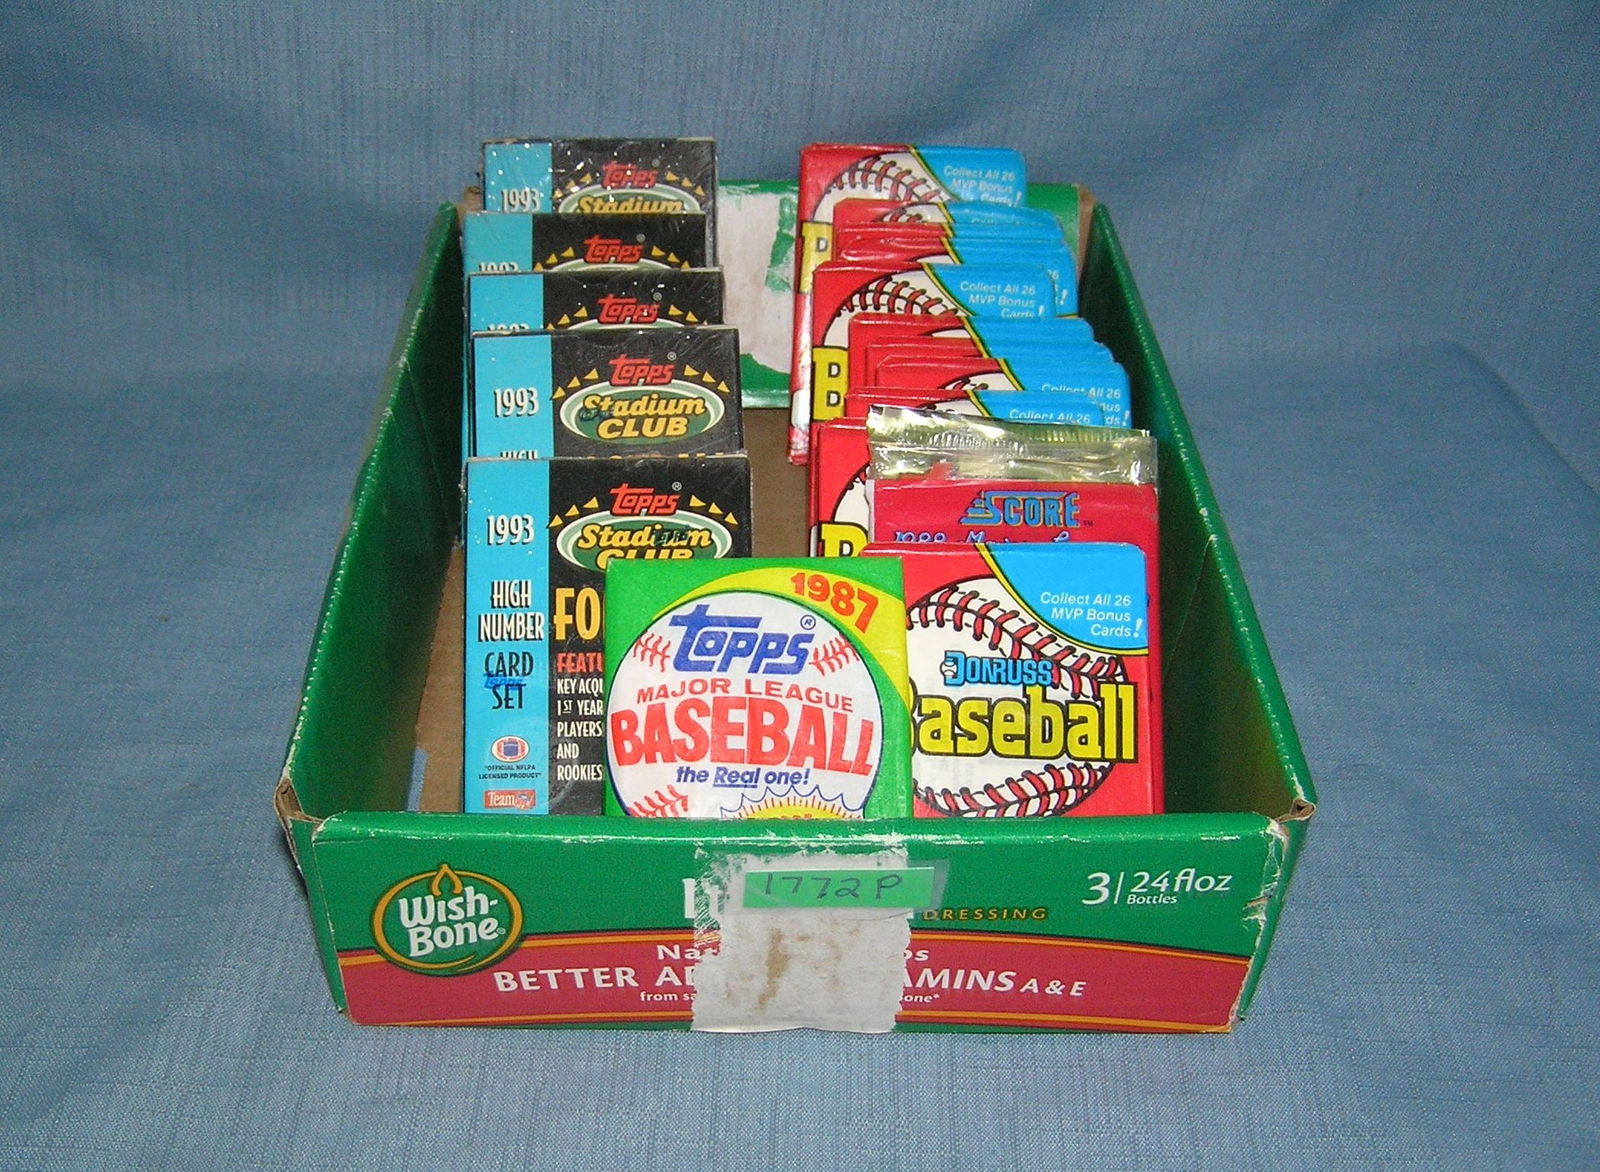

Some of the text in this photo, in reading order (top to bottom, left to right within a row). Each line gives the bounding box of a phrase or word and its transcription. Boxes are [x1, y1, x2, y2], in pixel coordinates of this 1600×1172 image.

[943, 165, 982, 177] Collect
[986, 169, 1000, 179] All
[960, 280, 1036, 295] Collect All 26
[969, 294, 1035, 307] MVP Bonus
[494, 387, 539, 417] 1993
[1106, 388, 1121, 399] 26
[597, 416, 689, 440] CLUB
[1077, 414, 1091, 424] 26
[959, 490, 1080, 528] SCORE
[487, 515, 535, 546] 1993
[491, 580, 532, 609] HIGH
[791, 572, 879, 634] 1987
[1040, 592, 1132, 607] Collect All 26
[1051, 608, 1131, 622] MVP Bonus
[479, 612, 544, 642] NUMBER
[484, 651, 534, 677] CARD
[492, 683, 527, 709] SET
[557, 679, 576, 695] KEY
[636, 678, 854, 713] MAJOR LEAGUE
[577, 700, 604, 715] YEAR
[557, 722, 603, 738] PLAYERS
[911, 682, 1139, 764] aseball
[610, 696, 874, 776] BASEBALL
[557, 743, 580, 759] AND
[478, 772, 509, 780] LICENSED
[557, 765, 603, 781] ROOKIES
[676, 766, 810, 788] the Real one!
[487, 792, 516, 806] Team
[1081, 872, 1111, 905] 3
[398, 886, 499, 929] Wish-
[1126, 893, 1178, 905] Bottles
[922, 907, 1047, 921] DRESSING
[408, 918, 498, 957] Bone
[493, 966, 637, 992] BETTER
[1019, 978, 1039, 994] A
[1044, 980, 1065, 995] &
[1069, 981, 1087, 996] E
[639, 991, 677, 1001] from
